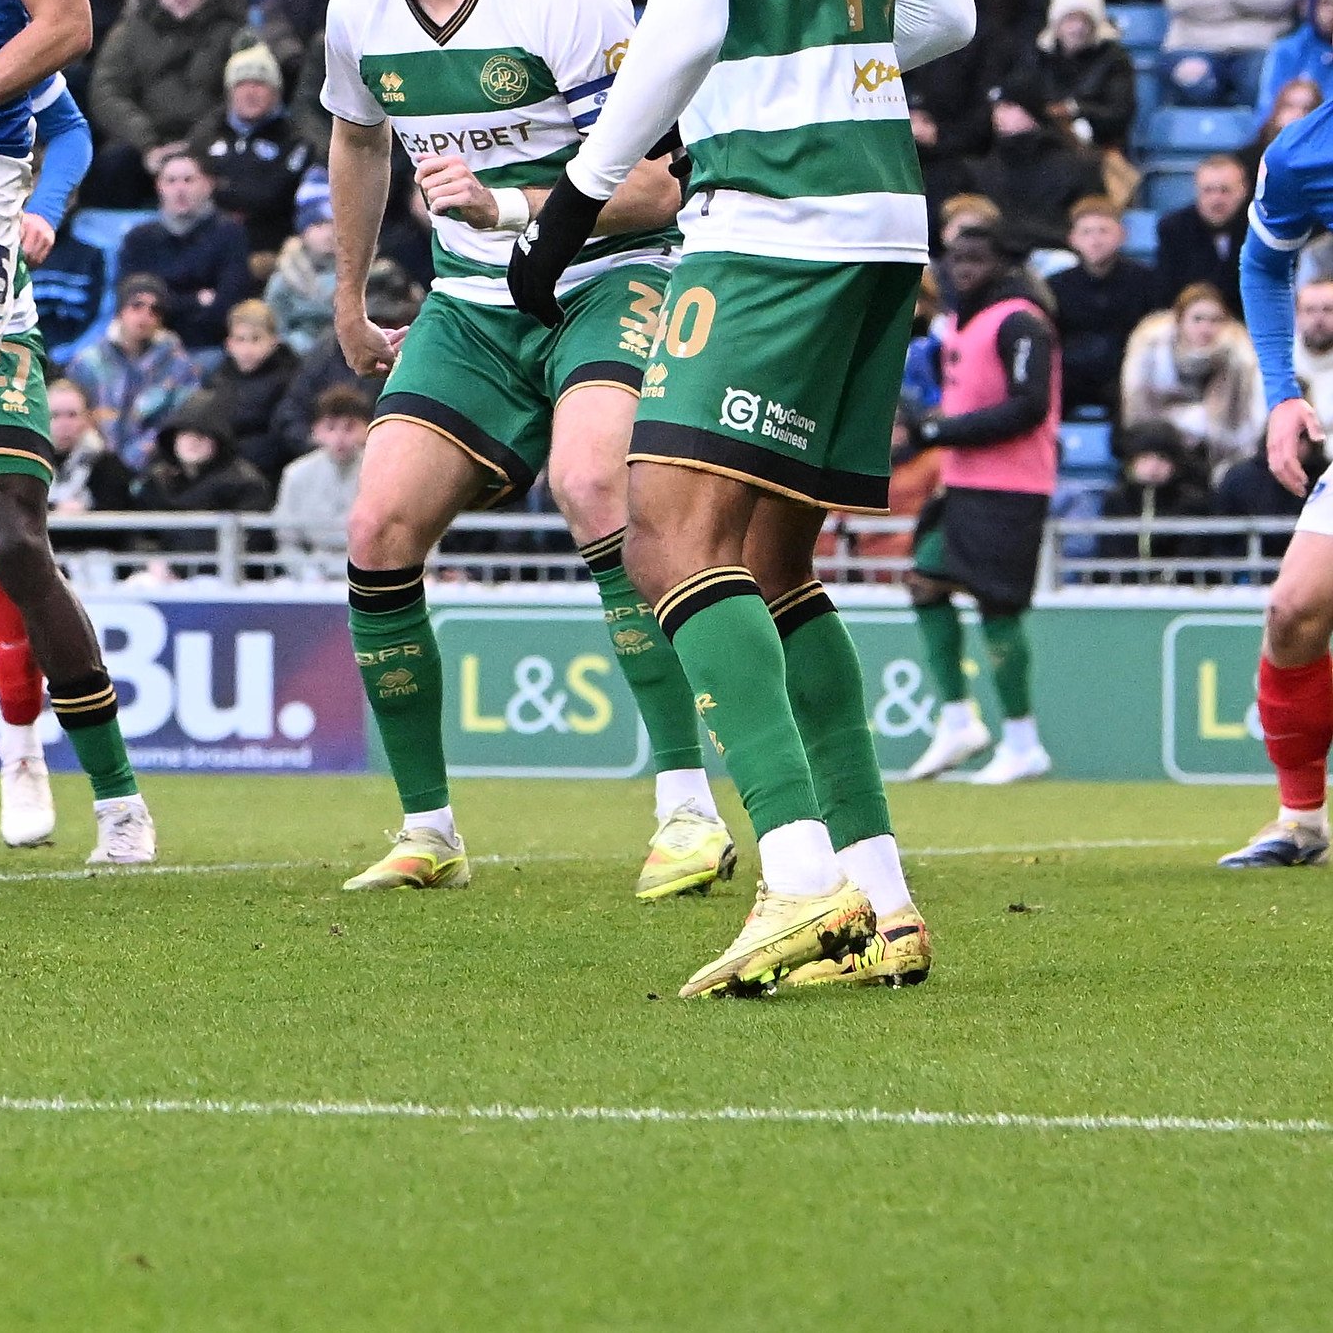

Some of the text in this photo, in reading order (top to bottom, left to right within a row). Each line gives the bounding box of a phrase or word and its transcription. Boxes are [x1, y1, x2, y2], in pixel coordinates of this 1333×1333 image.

[620, 280, 663, 337] 3
[765, 400, 816, 433] MyGuava
[761, 419, 808, 451] Business
[355, 645, 422, 666] QPR
[461, 654, 612, 734] L&S
